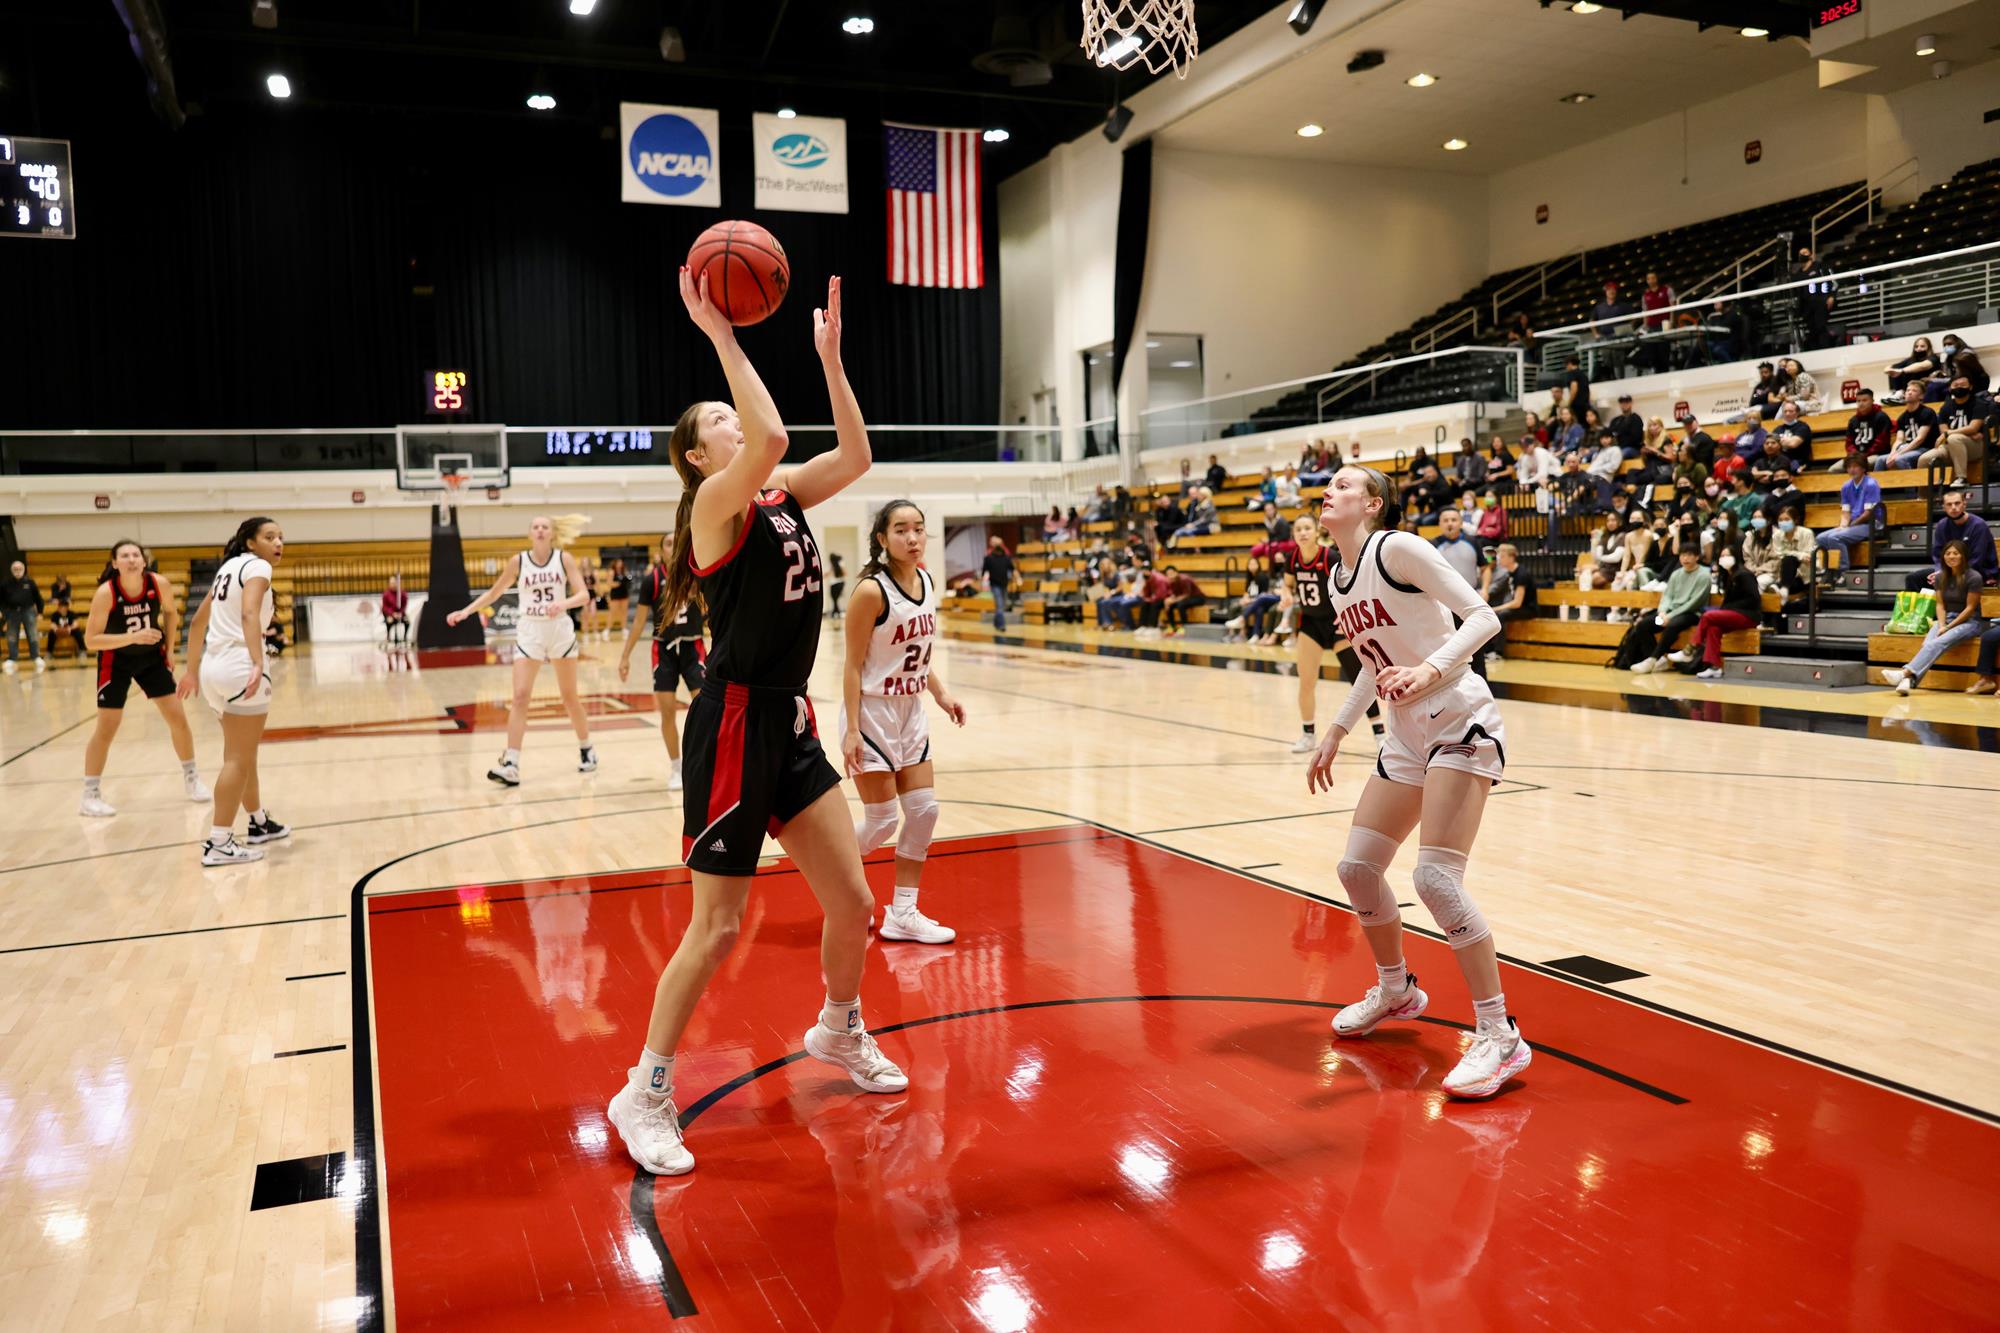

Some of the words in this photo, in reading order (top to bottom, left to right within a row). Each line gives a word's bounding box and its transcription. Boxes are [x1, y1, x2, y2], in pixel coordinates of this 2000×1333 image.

[637, 152, 710, 178] NCAA
[29, 177, 60, 201] 40
[756, 176, 784, 191] The
[785, 177, 847, 194] PacWest
[434, 385, 462, 409] 25
[783, 533, 821, 602] 23
[212, 573, 232, 602] 33
[524, 572, 562, 588] AZUSA
[532, 586, 555, 603] 35
[1298, 582, 1321, 607] 13
[123, 602, 151, 616] BIOLA
[1340, 598, 1398, 643] ZUSA
[126, 614, 151, 634] 21
[890, 613, 936, 645] AZUS
[902, 642, 932, 673] 24
